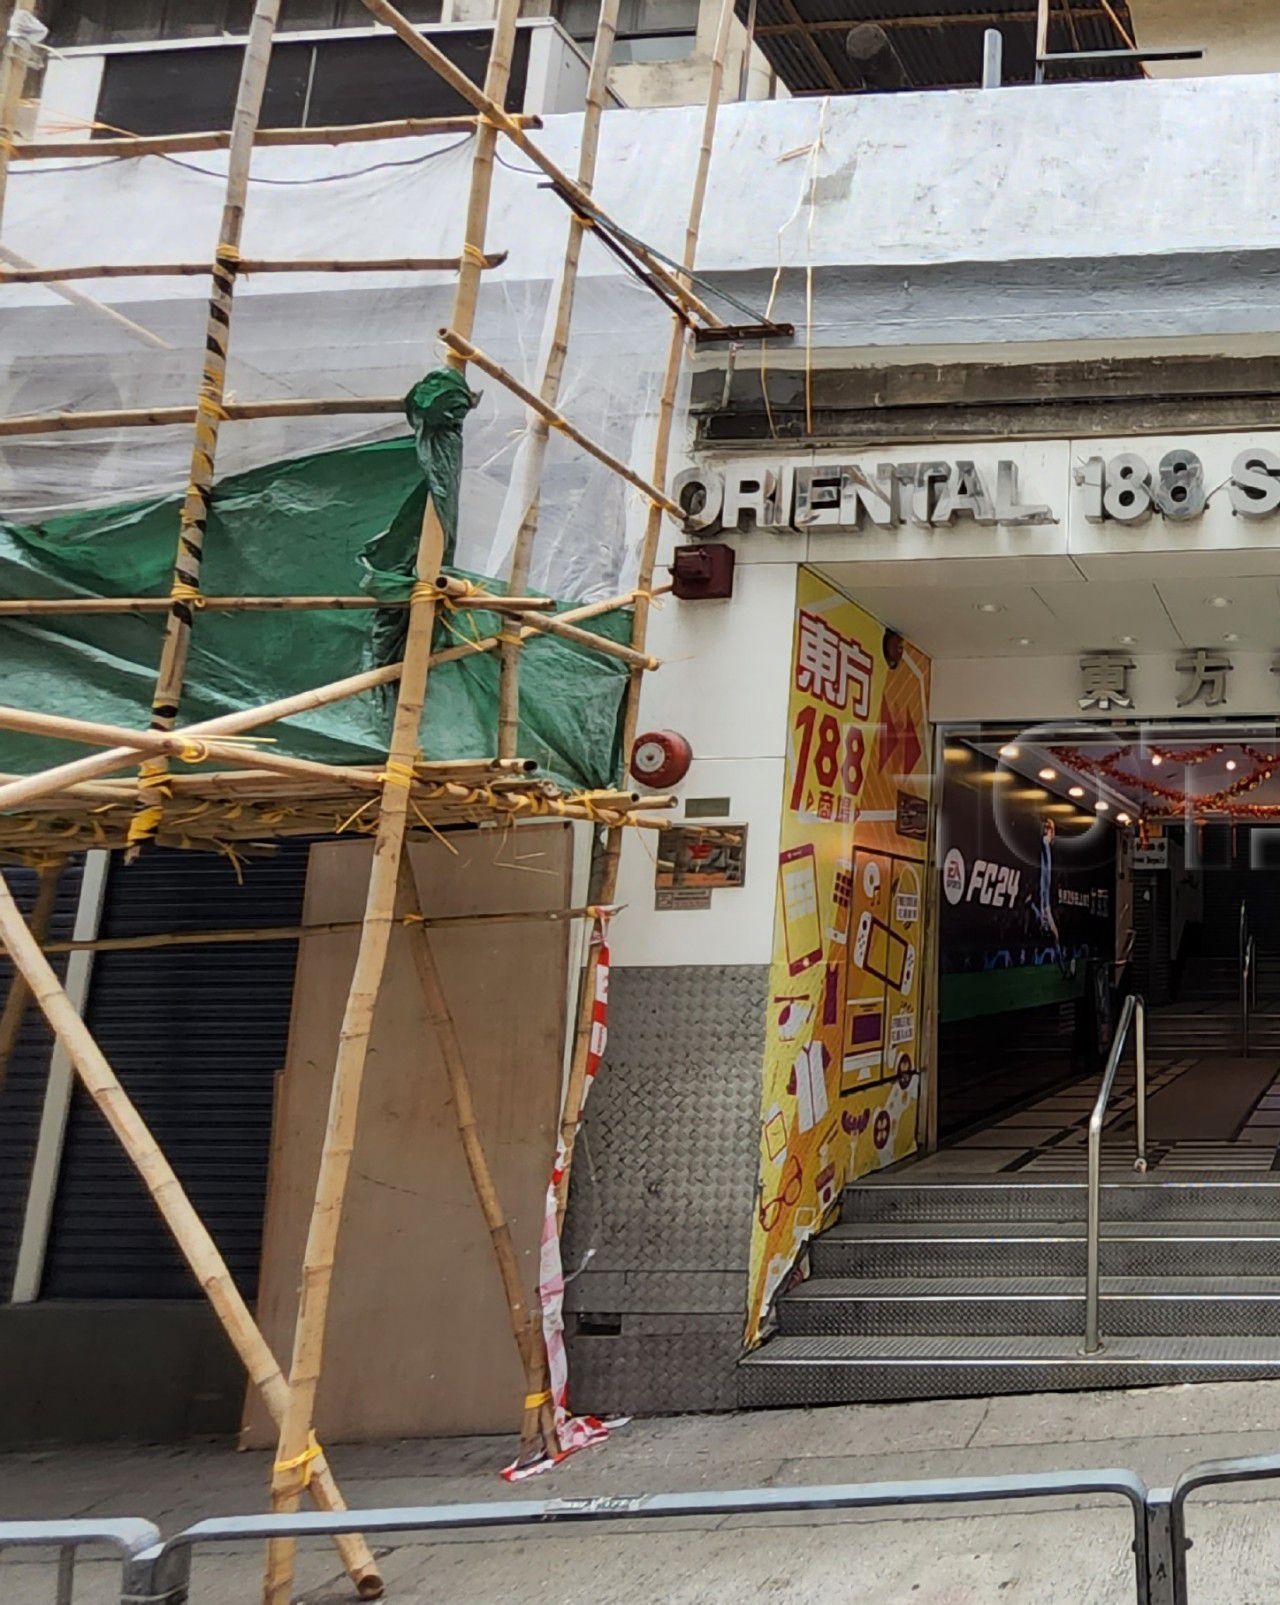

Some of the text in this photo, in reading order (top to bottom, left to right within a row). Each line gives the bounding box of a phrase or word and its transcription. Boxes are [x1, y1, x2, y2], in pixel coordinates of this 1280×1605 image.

[667, 458, 1057, 533] ORIENTAL
[1075, 449, 1206, 526] 188
[796, 608, 873, 721] 東方
[790, 705, 865, 811] 188
